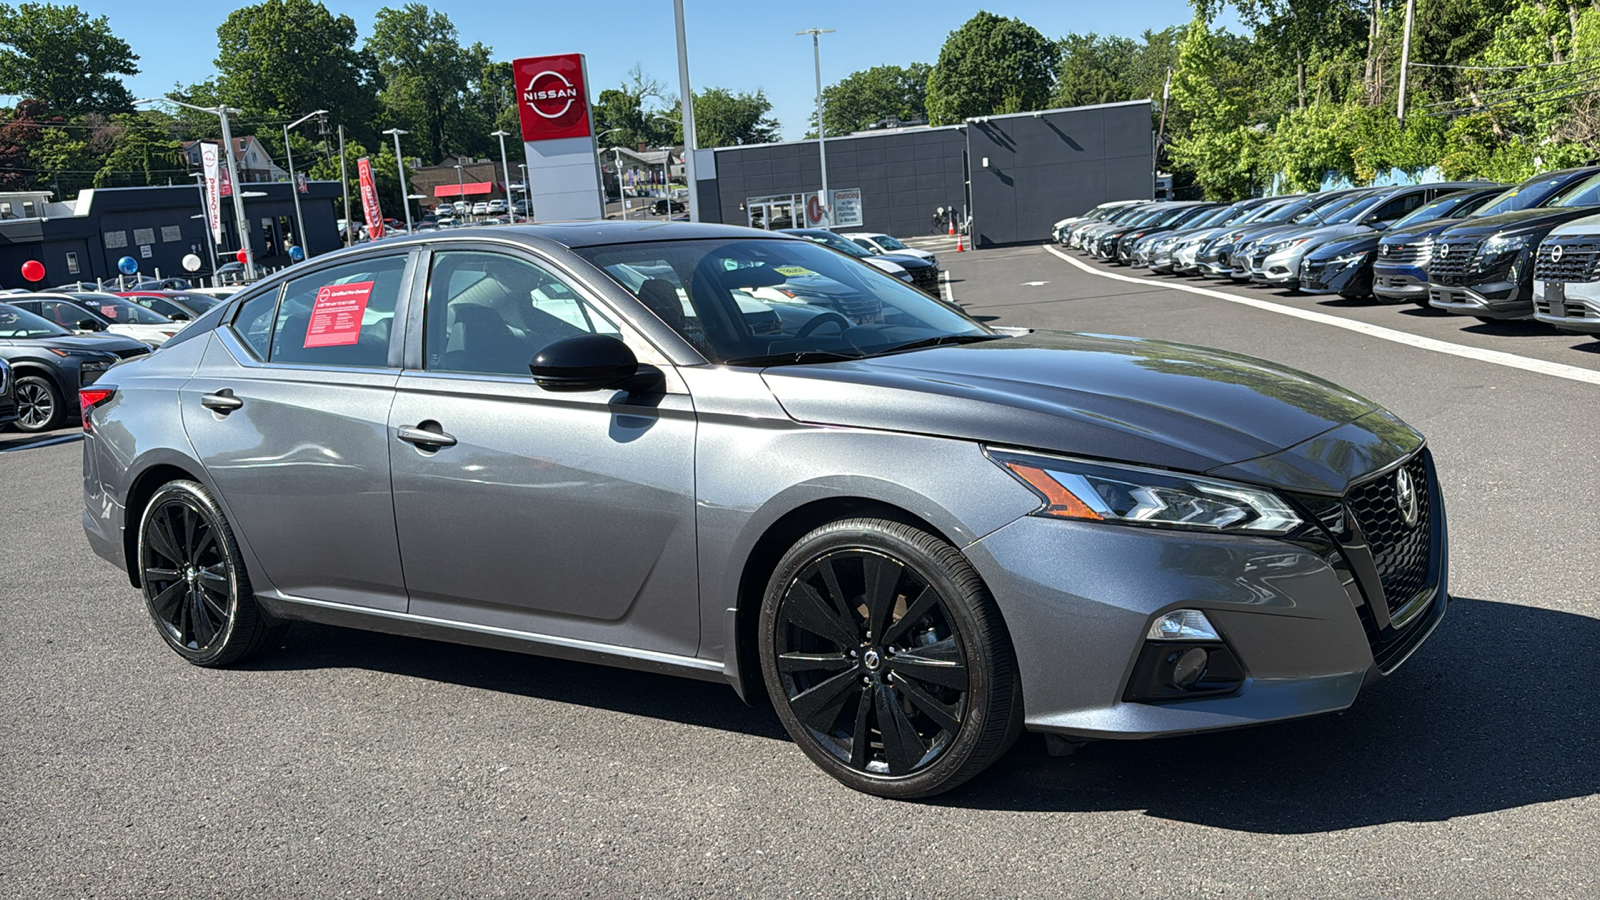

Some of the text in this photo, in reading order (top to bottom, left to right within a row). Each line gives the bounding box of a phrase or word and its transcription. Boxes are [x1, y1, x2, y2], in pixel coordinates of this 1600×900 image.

[523, 88, 577, 101] NISSAN
[834, 191, 859, 200] Financing
[208, 178, 218, 229] Pre-Owned
